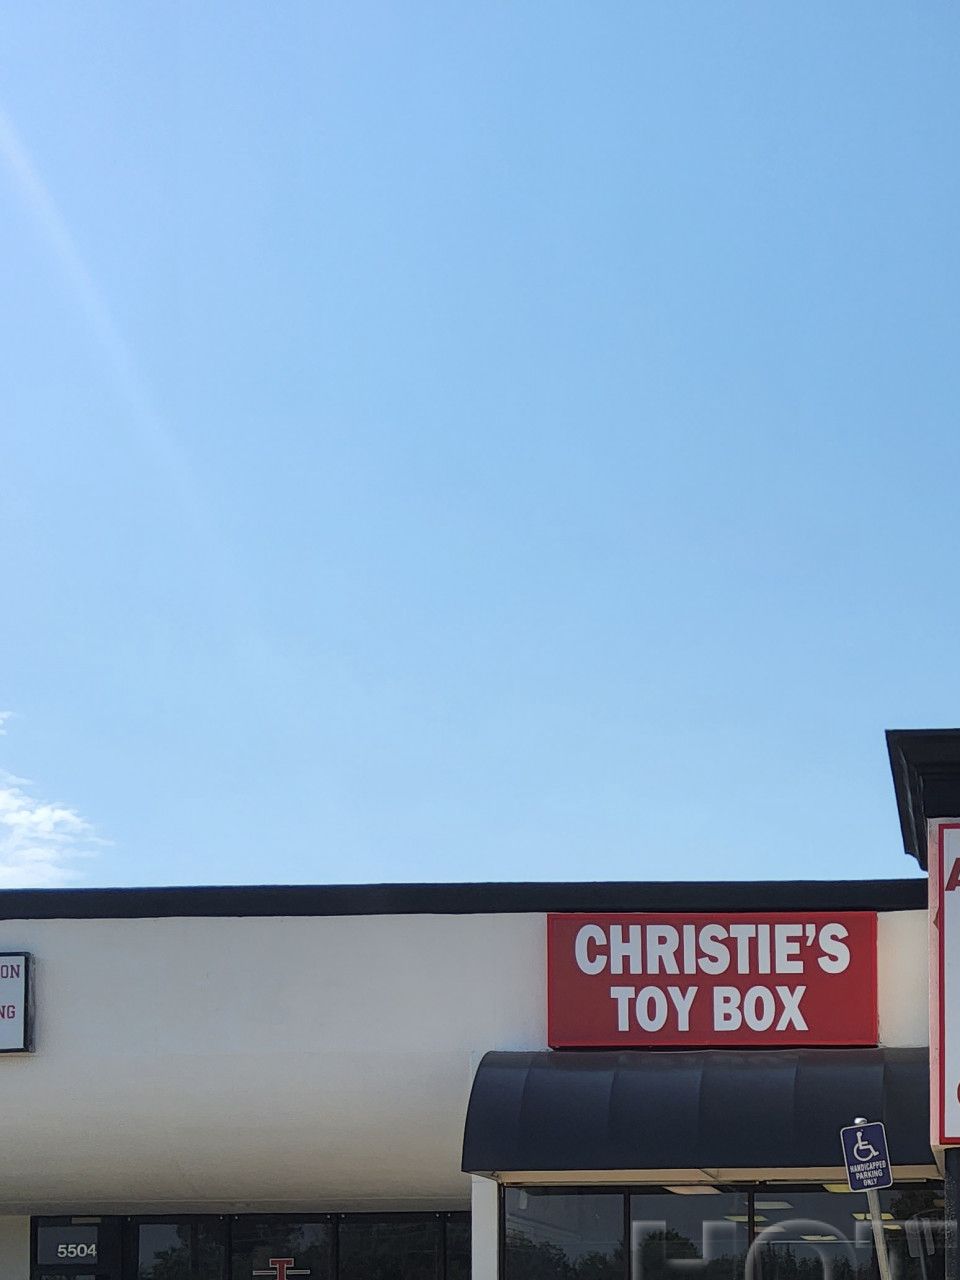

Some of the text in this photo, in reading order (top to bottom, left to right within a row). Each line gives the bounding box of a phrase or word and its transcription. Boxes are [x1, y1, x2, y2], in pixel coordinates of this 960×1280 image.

[575, 923, 851, 975] CHRISTIE'S
[610, 985, 809, 1032] TOY BOX
[850, 1160, 887, 1173] HANDICAPPED
[856, 1169, 883, 1180] PARKING
[863, 1178, 878, 1186] ONLY
[57, 1244, 97, 1258] 5504
